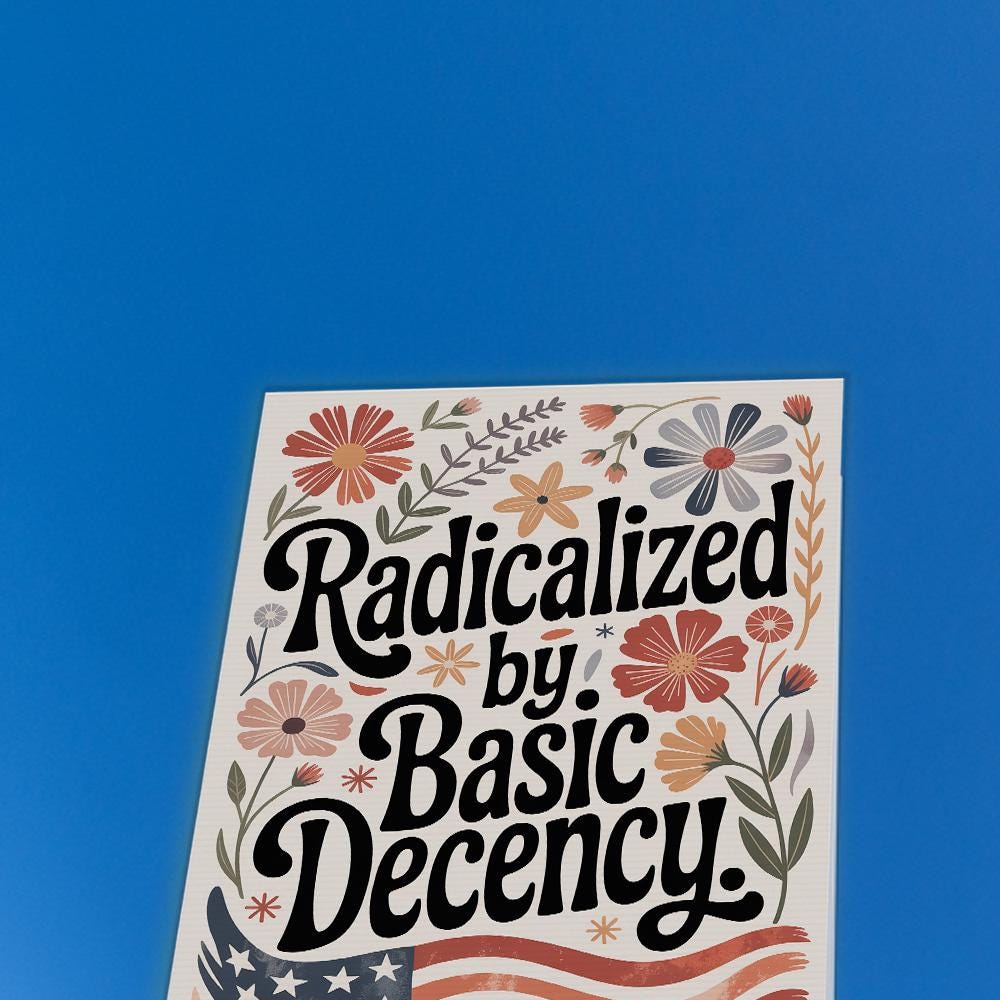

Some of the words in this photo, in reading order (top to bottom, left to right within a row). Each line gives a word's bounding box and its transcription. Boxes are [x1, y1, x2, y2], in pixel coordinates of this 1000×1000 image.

[264, 480, 794, 678] Radicalized
[483, 632, 577, 720] by
[359, 690, 649, 831] Basic
[253, 797, 763, 952] Decency.
